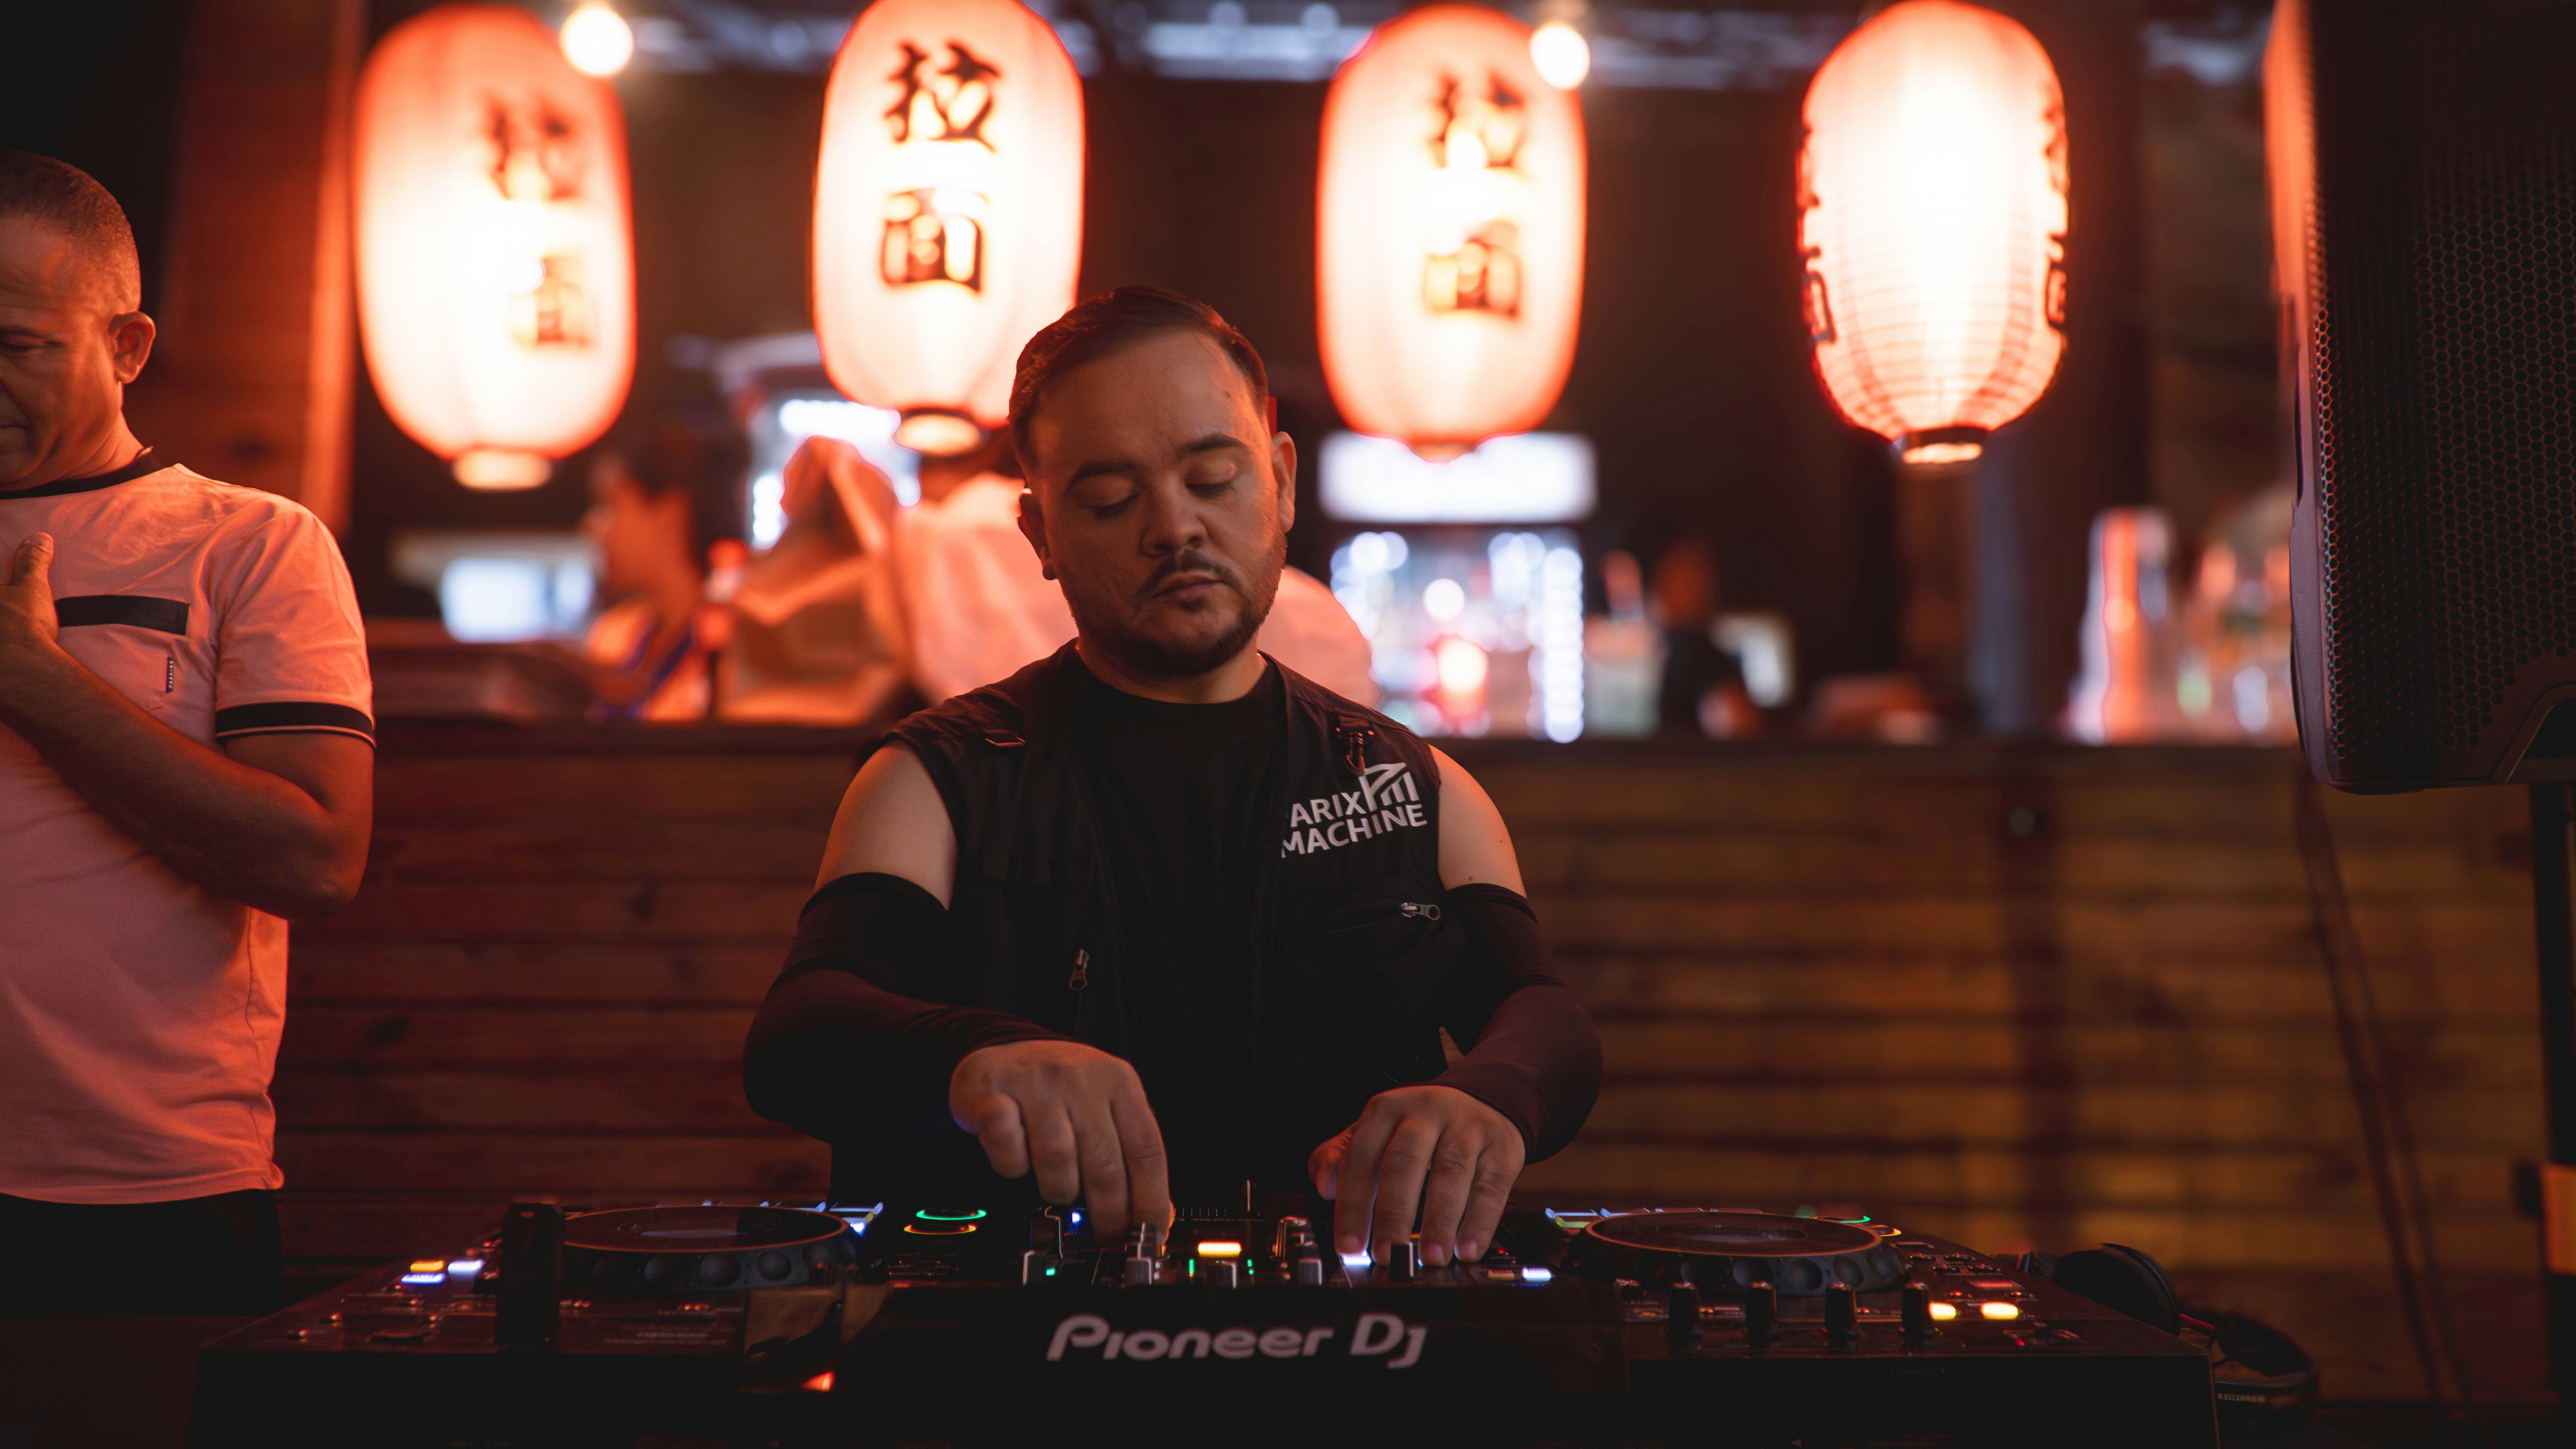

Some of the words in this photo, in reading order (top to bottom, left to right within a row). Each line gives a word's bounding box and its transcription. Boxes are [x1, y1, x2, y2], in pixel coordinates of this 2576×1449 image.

[1282, 804, 1427, 858] MACHINE
[1286, 791, 1366, 828] ARIX
[1046, 1313, 1335, 1361] Pioneer
